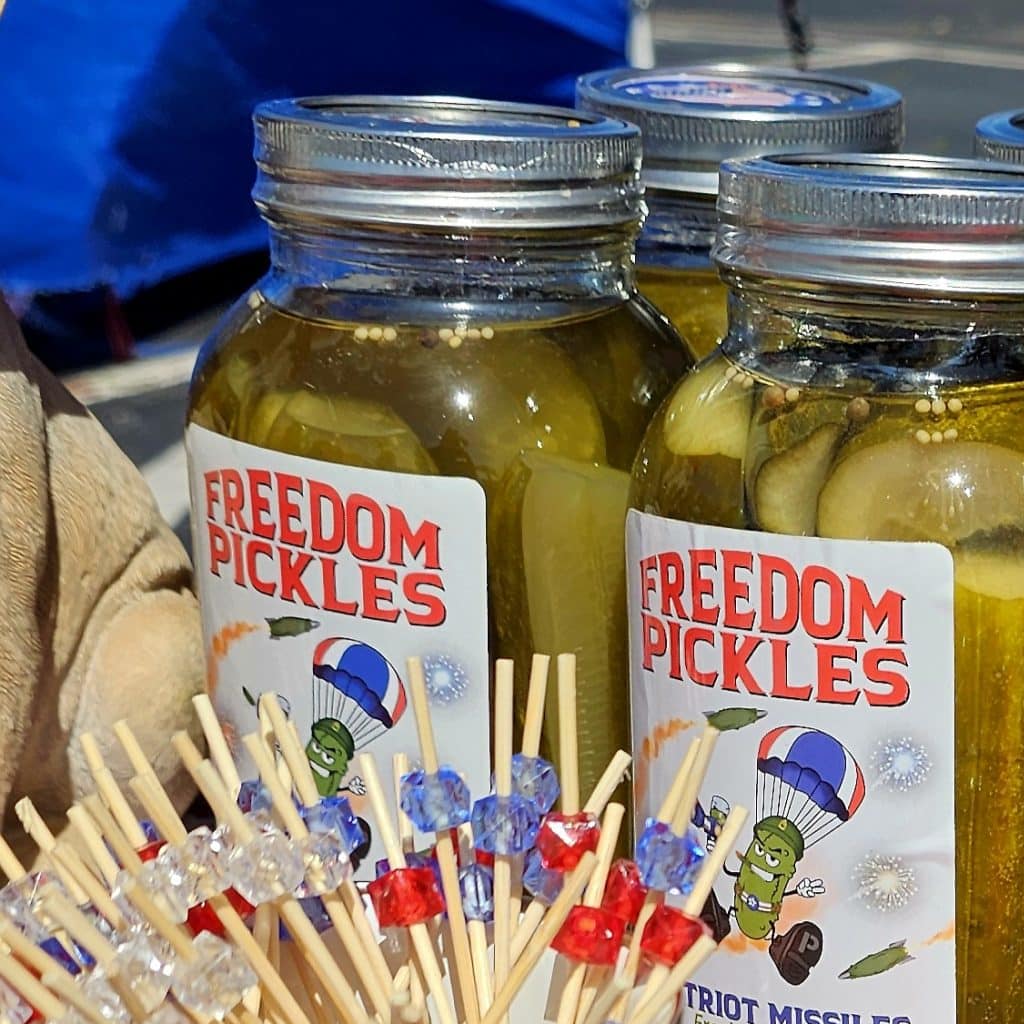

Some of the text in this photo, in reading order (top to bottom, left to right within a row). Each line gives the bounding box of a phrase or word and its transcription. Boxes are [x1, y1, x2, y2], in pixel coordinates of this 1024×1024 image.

[204, 468, 442, 570] FREEDOM
[207, 522, 447, 627] PICKLES
[640, 549, 907, 645] FREEDOM
[640, 613, 911, 708] PICKLES
[684, 982, 760, 1024] TRIOT
